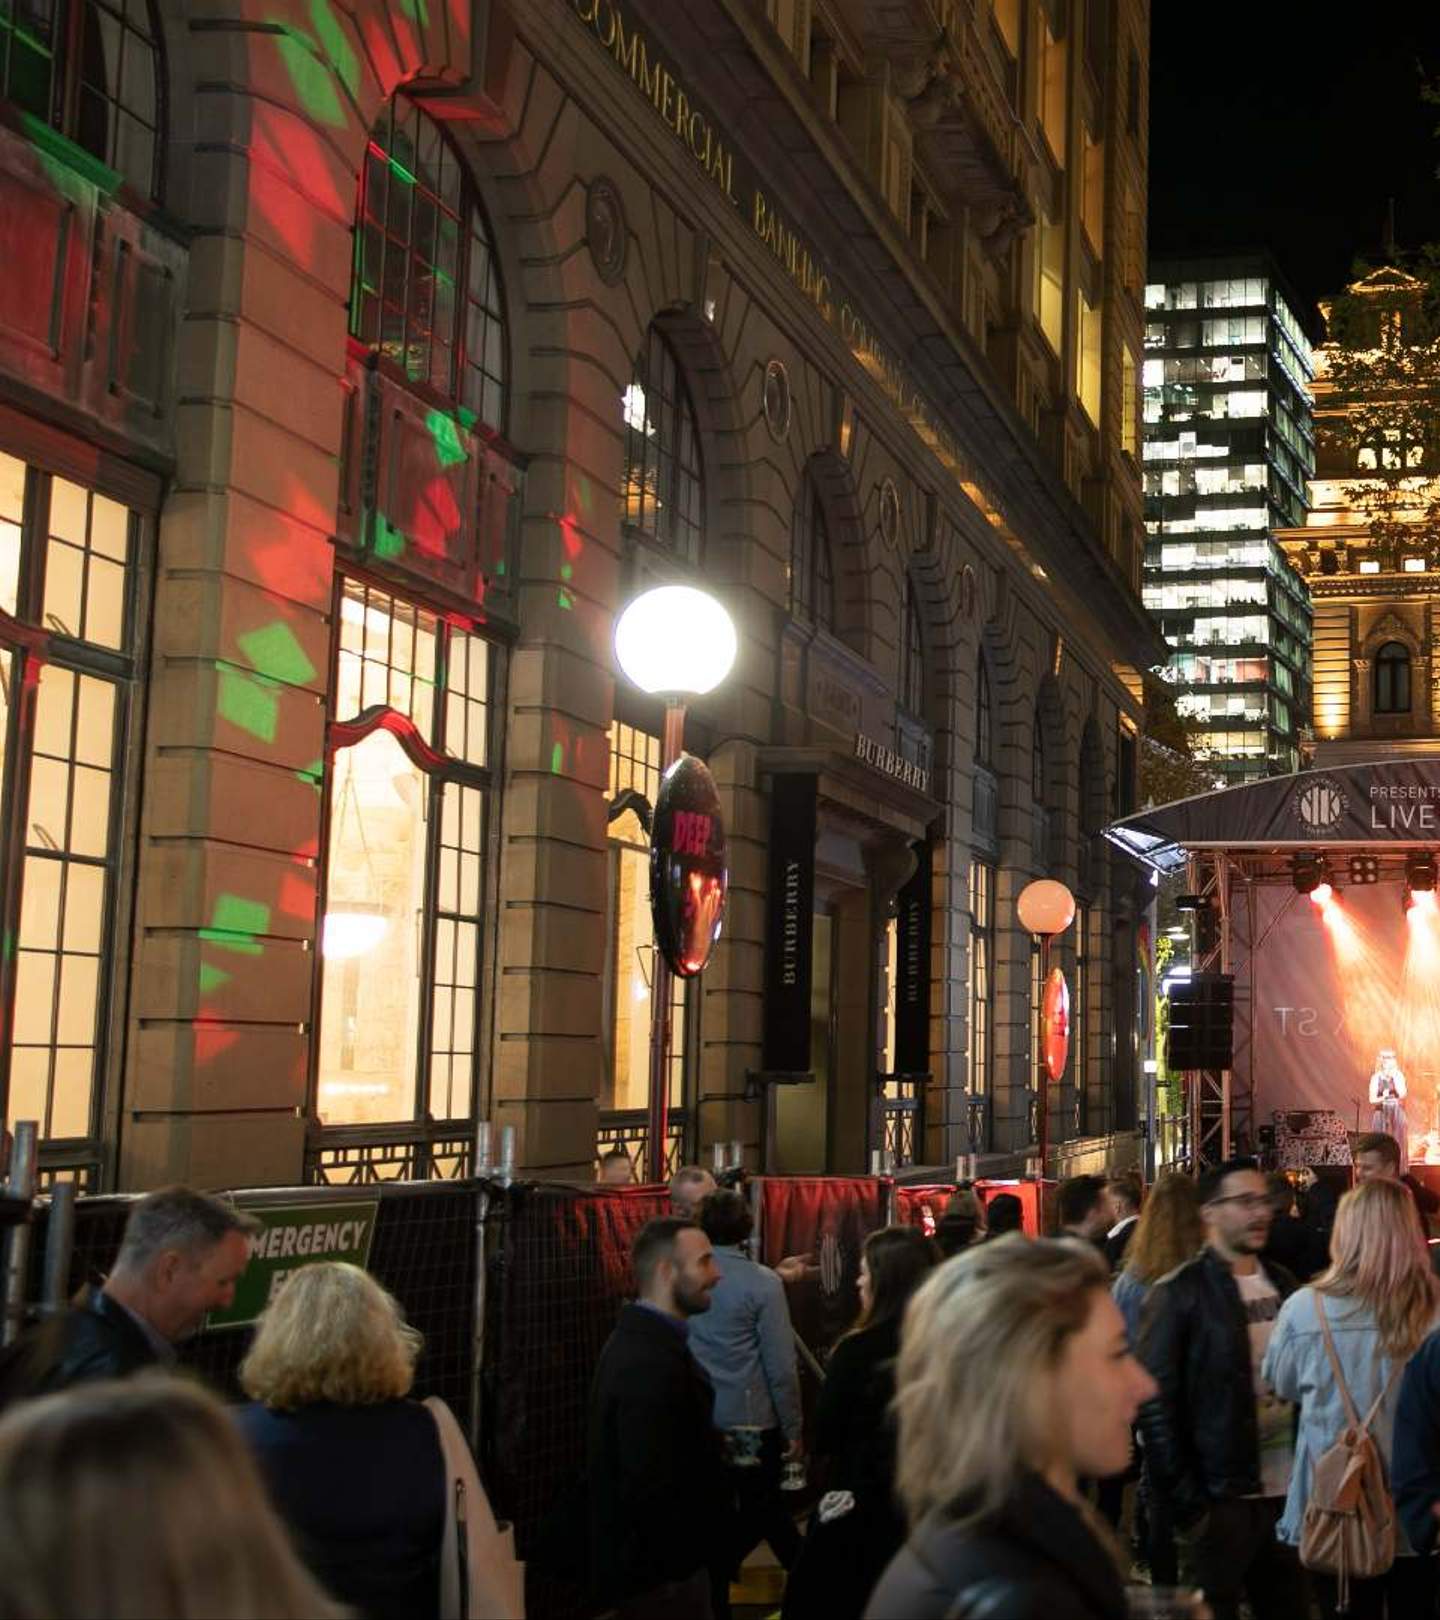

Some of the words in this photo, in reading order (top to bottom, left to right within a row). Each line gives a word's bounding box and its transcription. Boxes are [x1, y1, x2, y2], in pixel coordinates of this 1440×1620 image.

[856, 733, 930, 792] BURBERRY
[1371, 804, 1436, 829] LIVE
[784, 863, 799, 984] BURBERRY
[247, 1221, 367, 1259] MERGENCY
